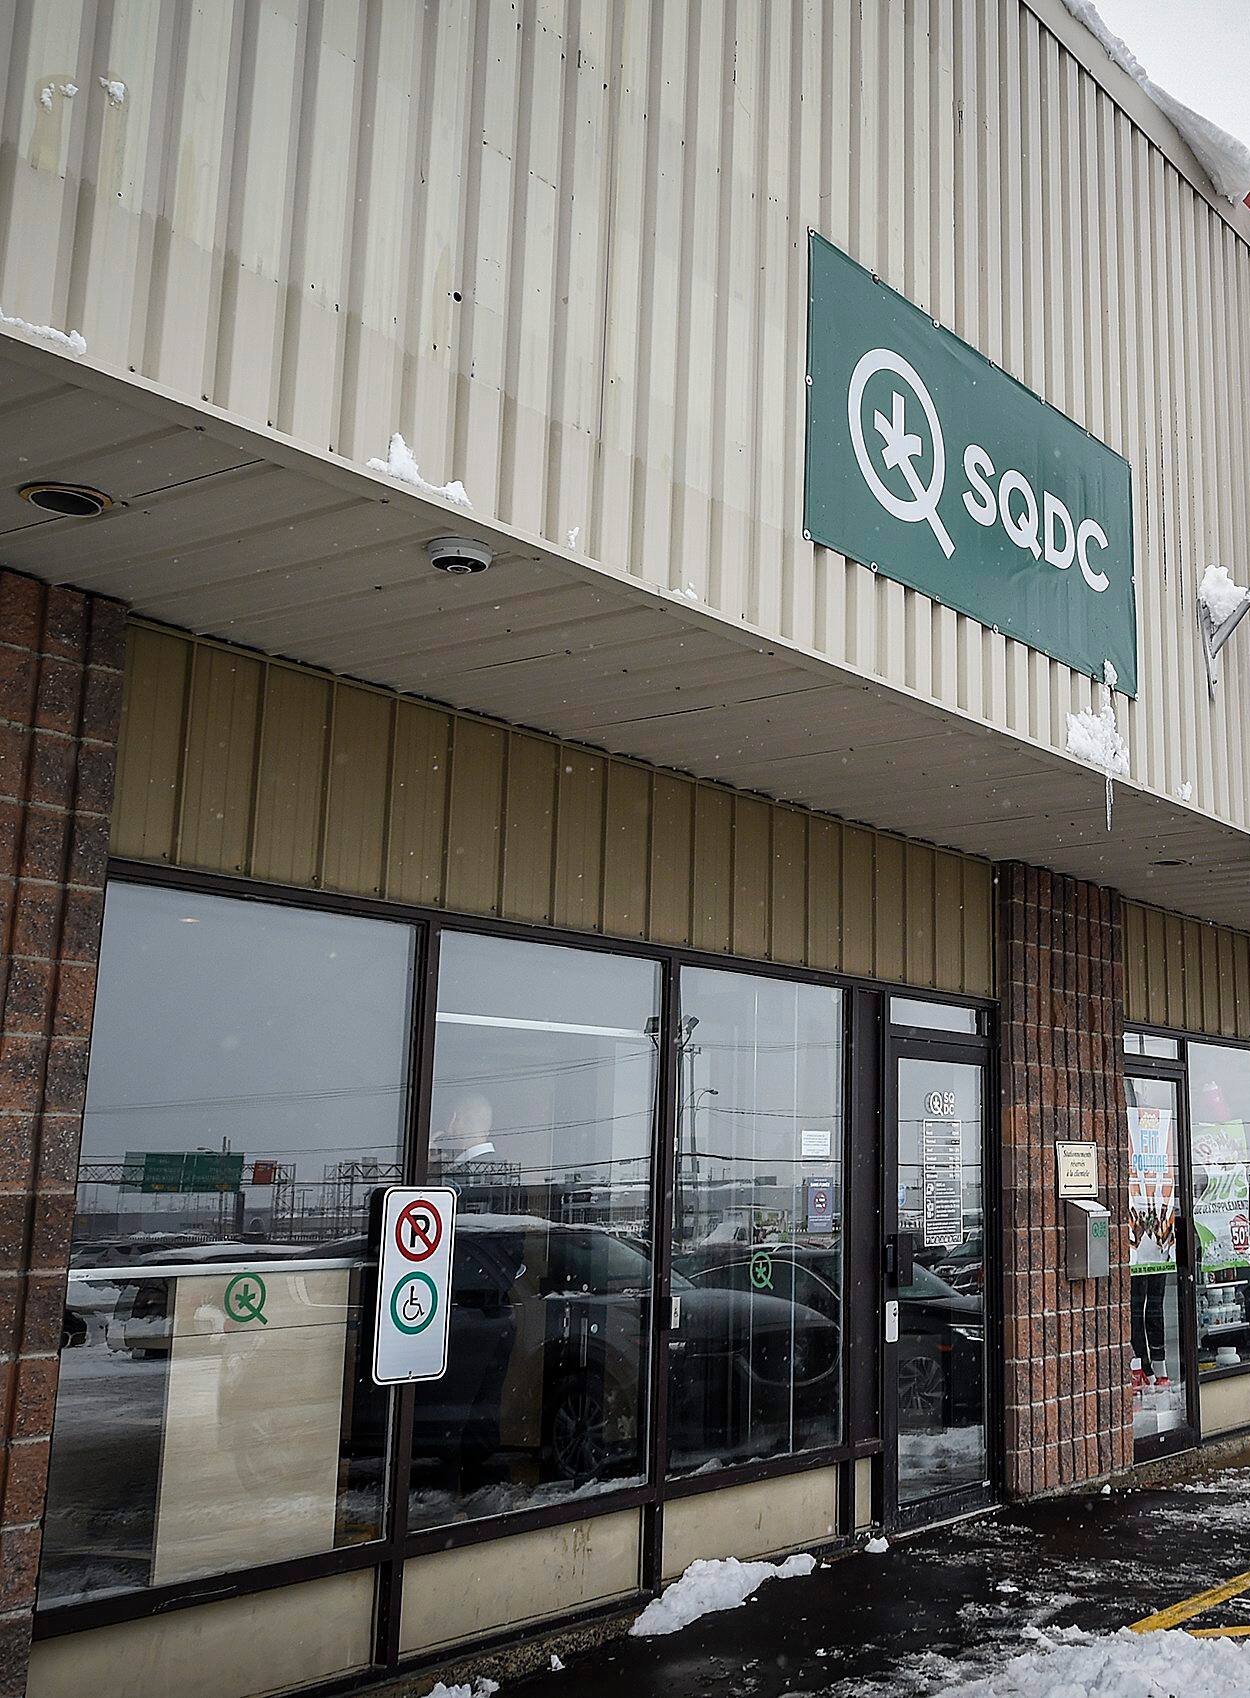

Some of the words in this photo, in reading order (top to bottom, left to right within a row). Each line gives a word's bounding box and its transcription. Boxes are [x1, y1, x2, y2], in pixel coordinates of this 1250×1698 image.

[962, 444, 1110, 592] SQDC
[944, 1092, 955, 1103] SQ
[944, 1103, 955, 1115] DC
